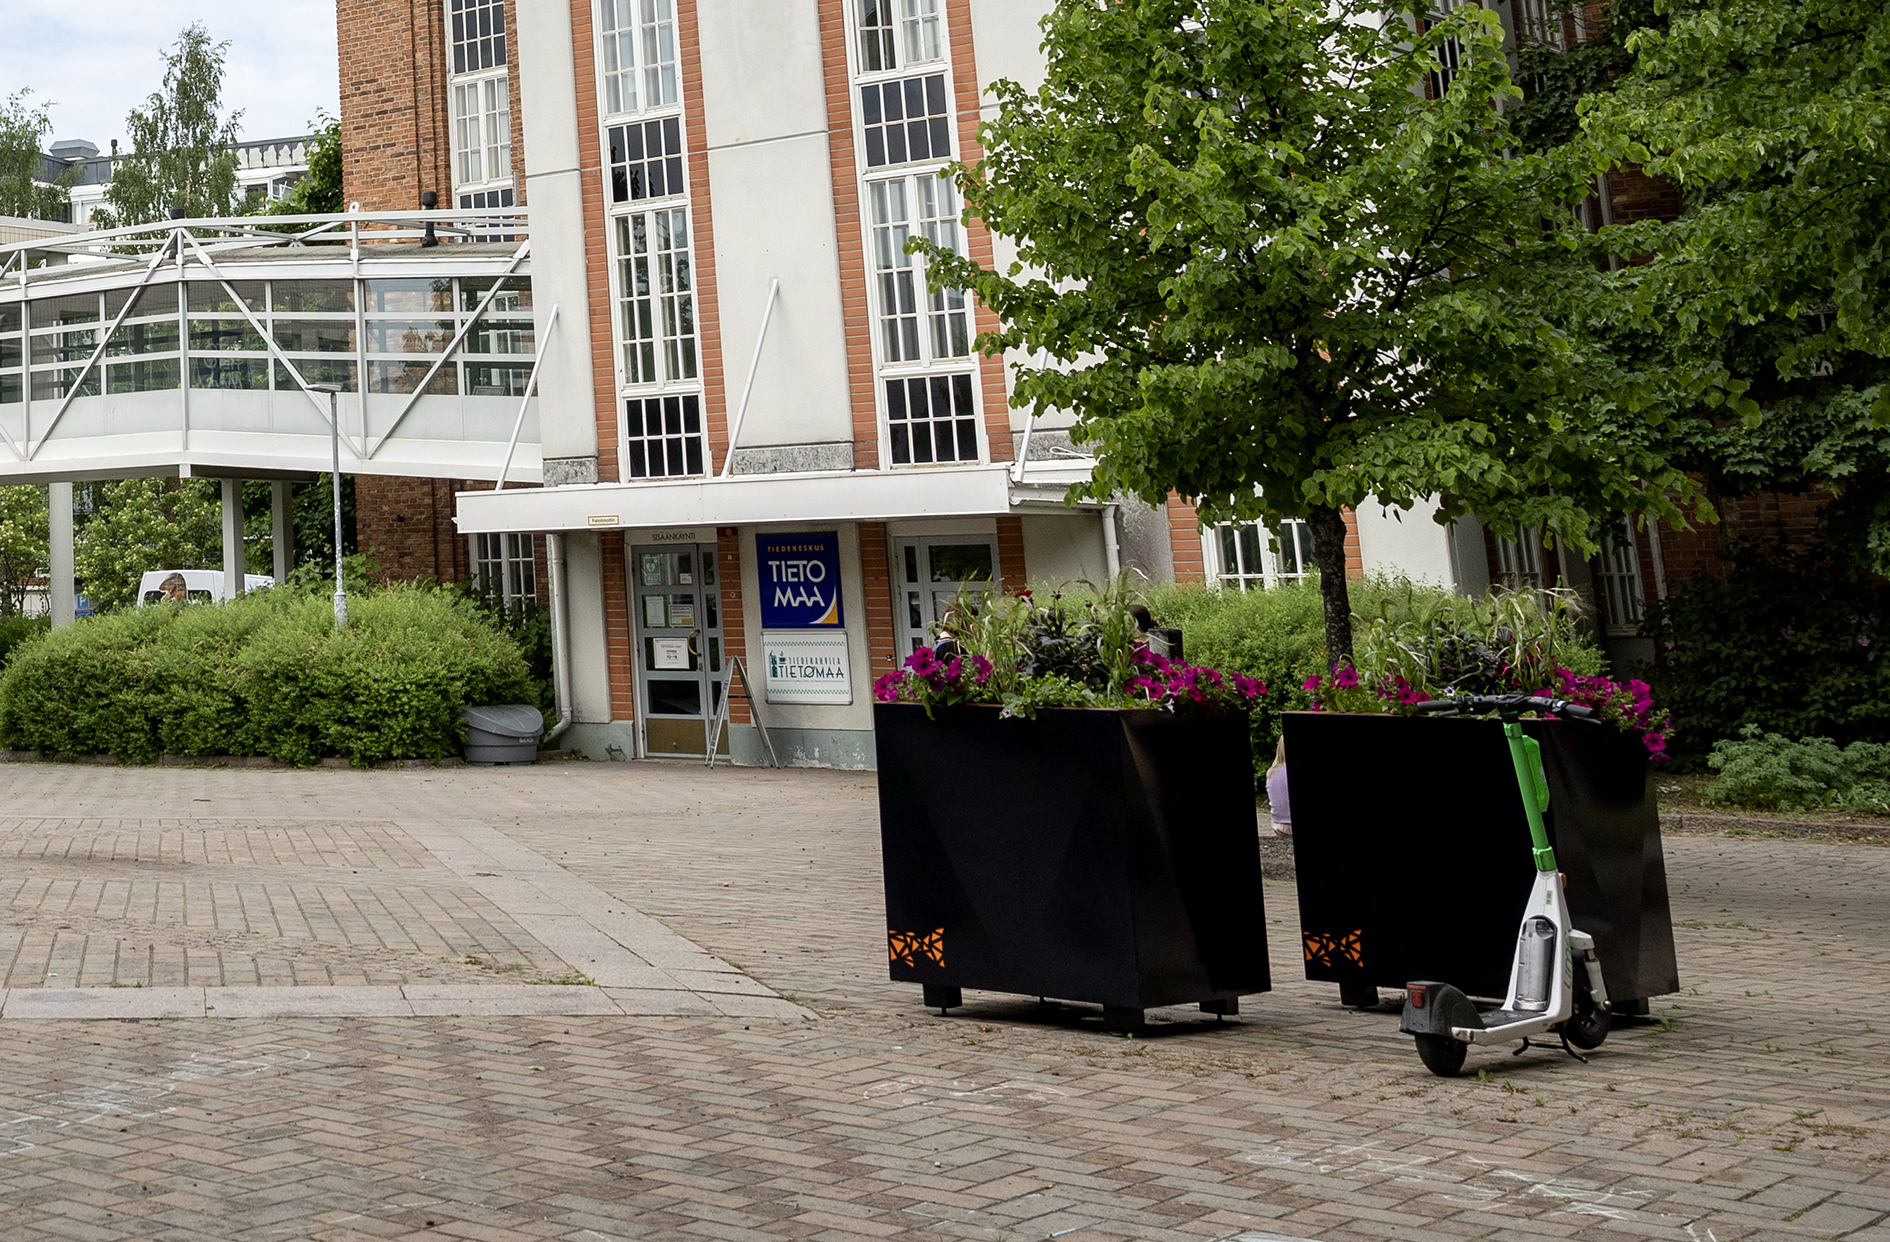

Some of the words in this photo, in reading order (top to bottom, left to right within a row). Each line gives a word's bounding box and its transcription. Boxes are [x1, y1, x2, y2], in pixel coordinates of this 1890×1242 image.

[767, 544, 824, 553] TIEDEKESKUS
[768, 560, 826, 583] TIETO
[79, 596, 87, 607] P
[774, 585, 826, 607] MAA
[789, 657, 841, 665] TIEDEKAHVILA
